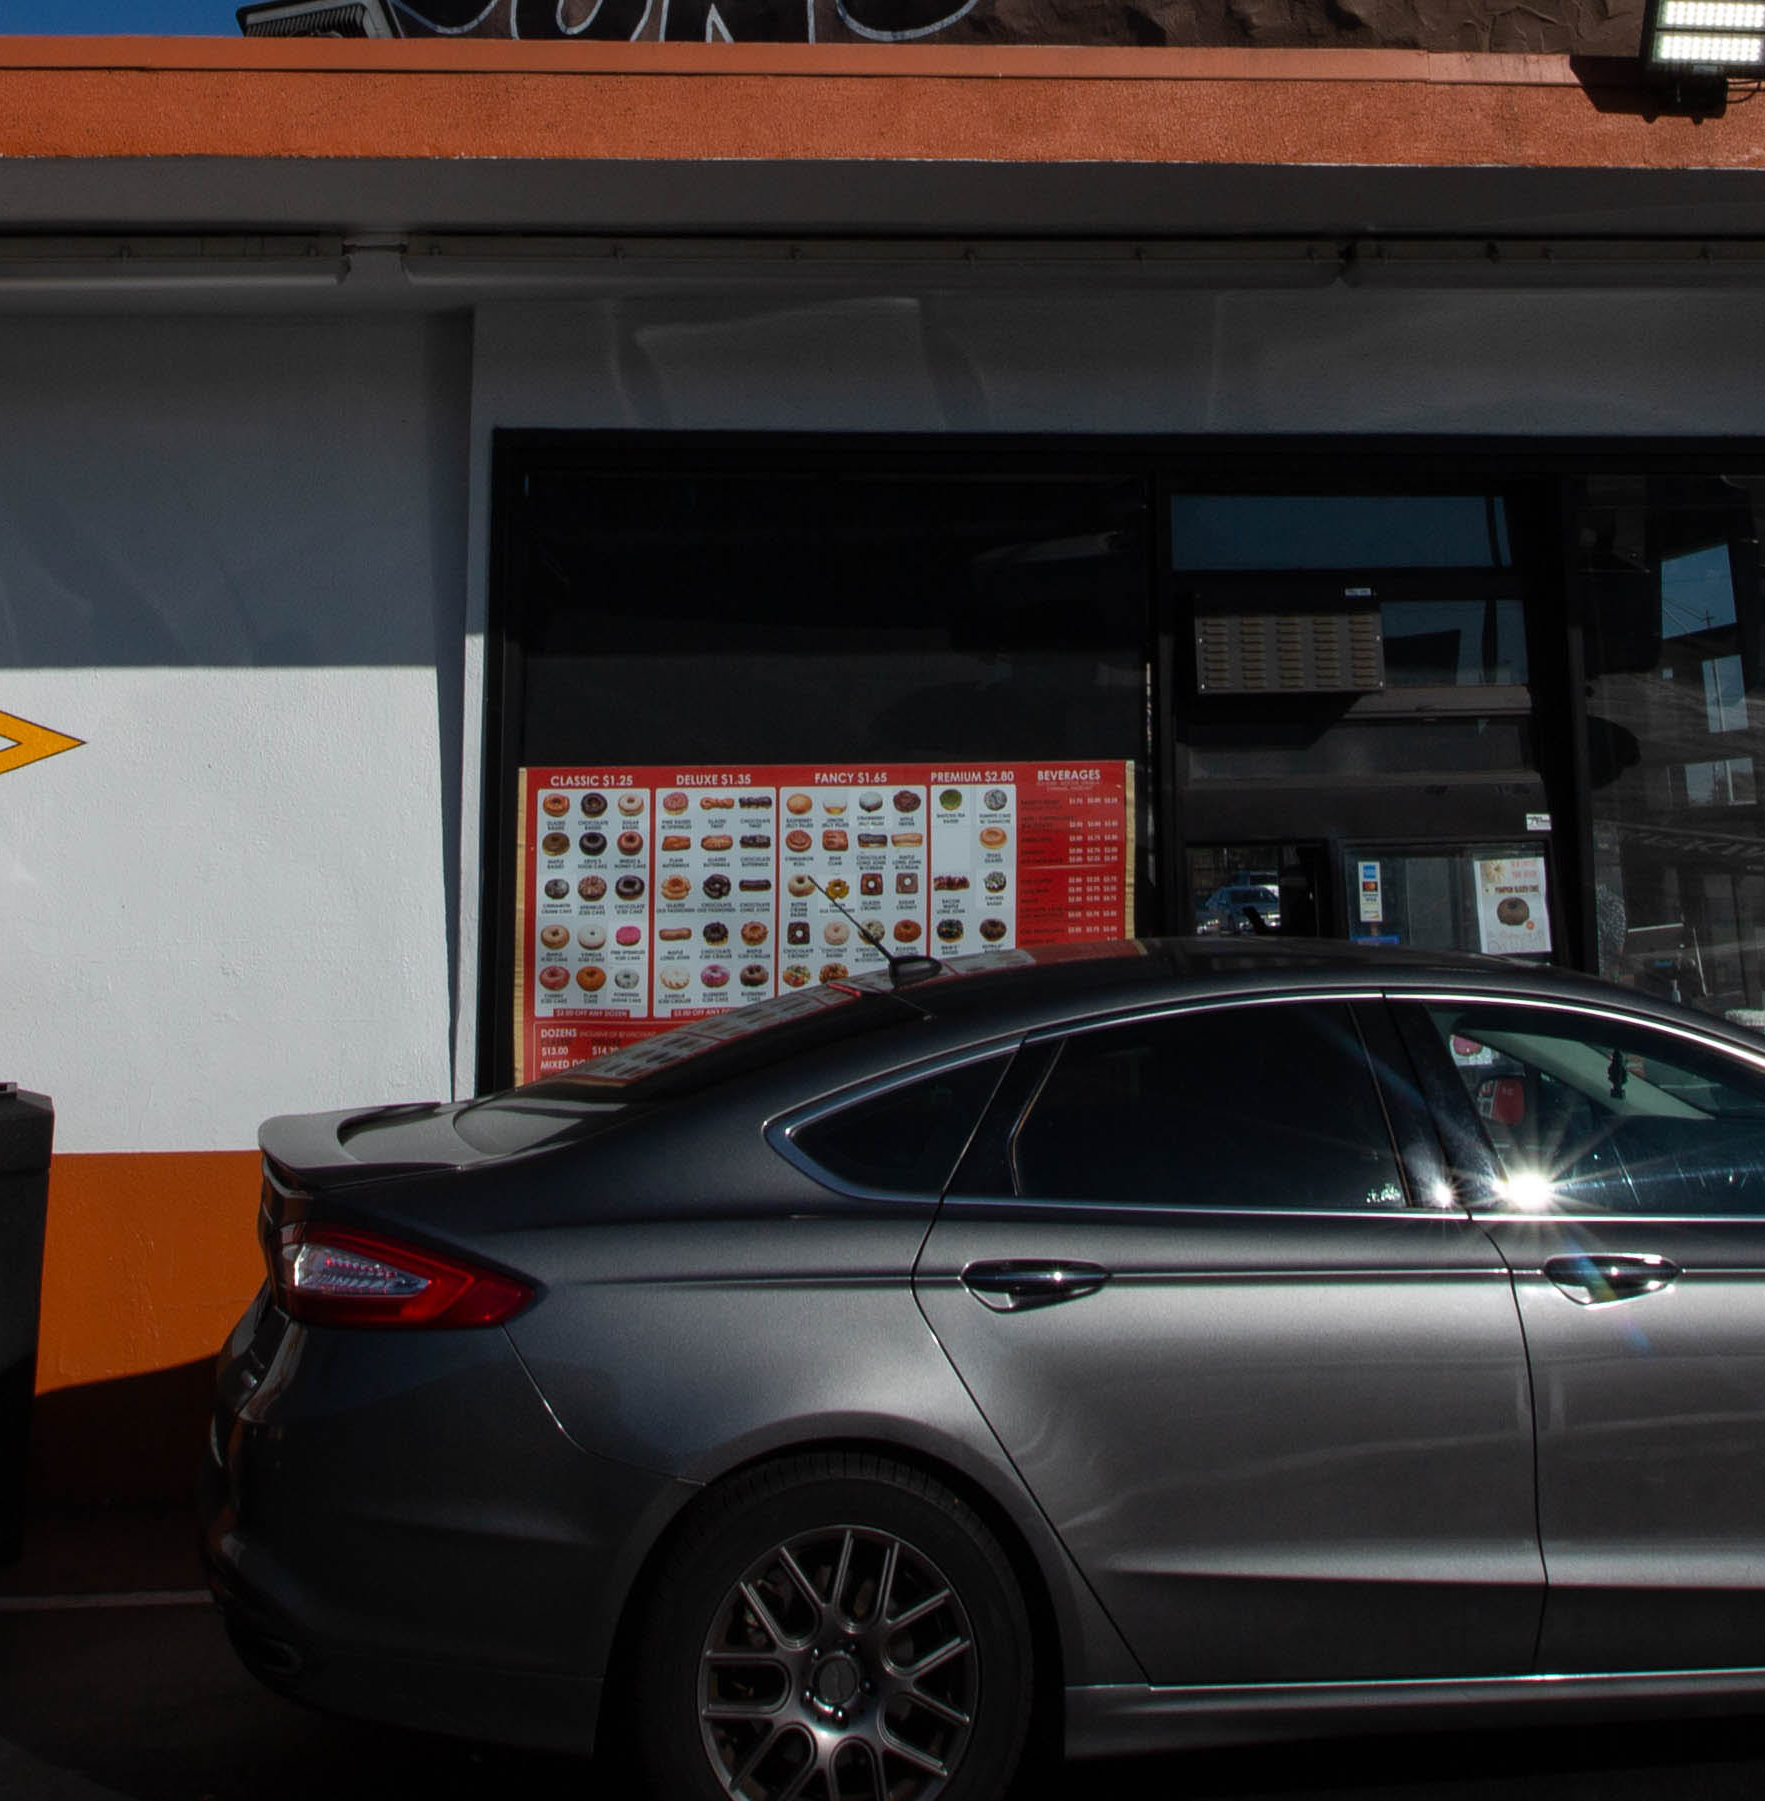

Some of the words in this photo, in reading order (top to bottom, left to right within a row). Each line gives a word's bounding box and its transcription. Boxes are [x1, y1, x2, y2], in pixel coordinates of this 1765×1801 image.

[550, 775, 598, 786] CLASSIC
[602, 775, 633, 786] $1.25
[676, 774, 718, 785] DELUXE
[721, 774, 751, 785] $1.35
[815, 772, 854, 784] FANCY
[857, 772, 888, 784] $1.65
[931, 771, 981, 782] PREMIUM
[984, 771, 1014, 782] $2.80
[1037, 769, 1100, 781] BEVERAGES
[540, 1028, 578, 1038] DOZENS
[540, 1059, 570, 1070] MIXED
